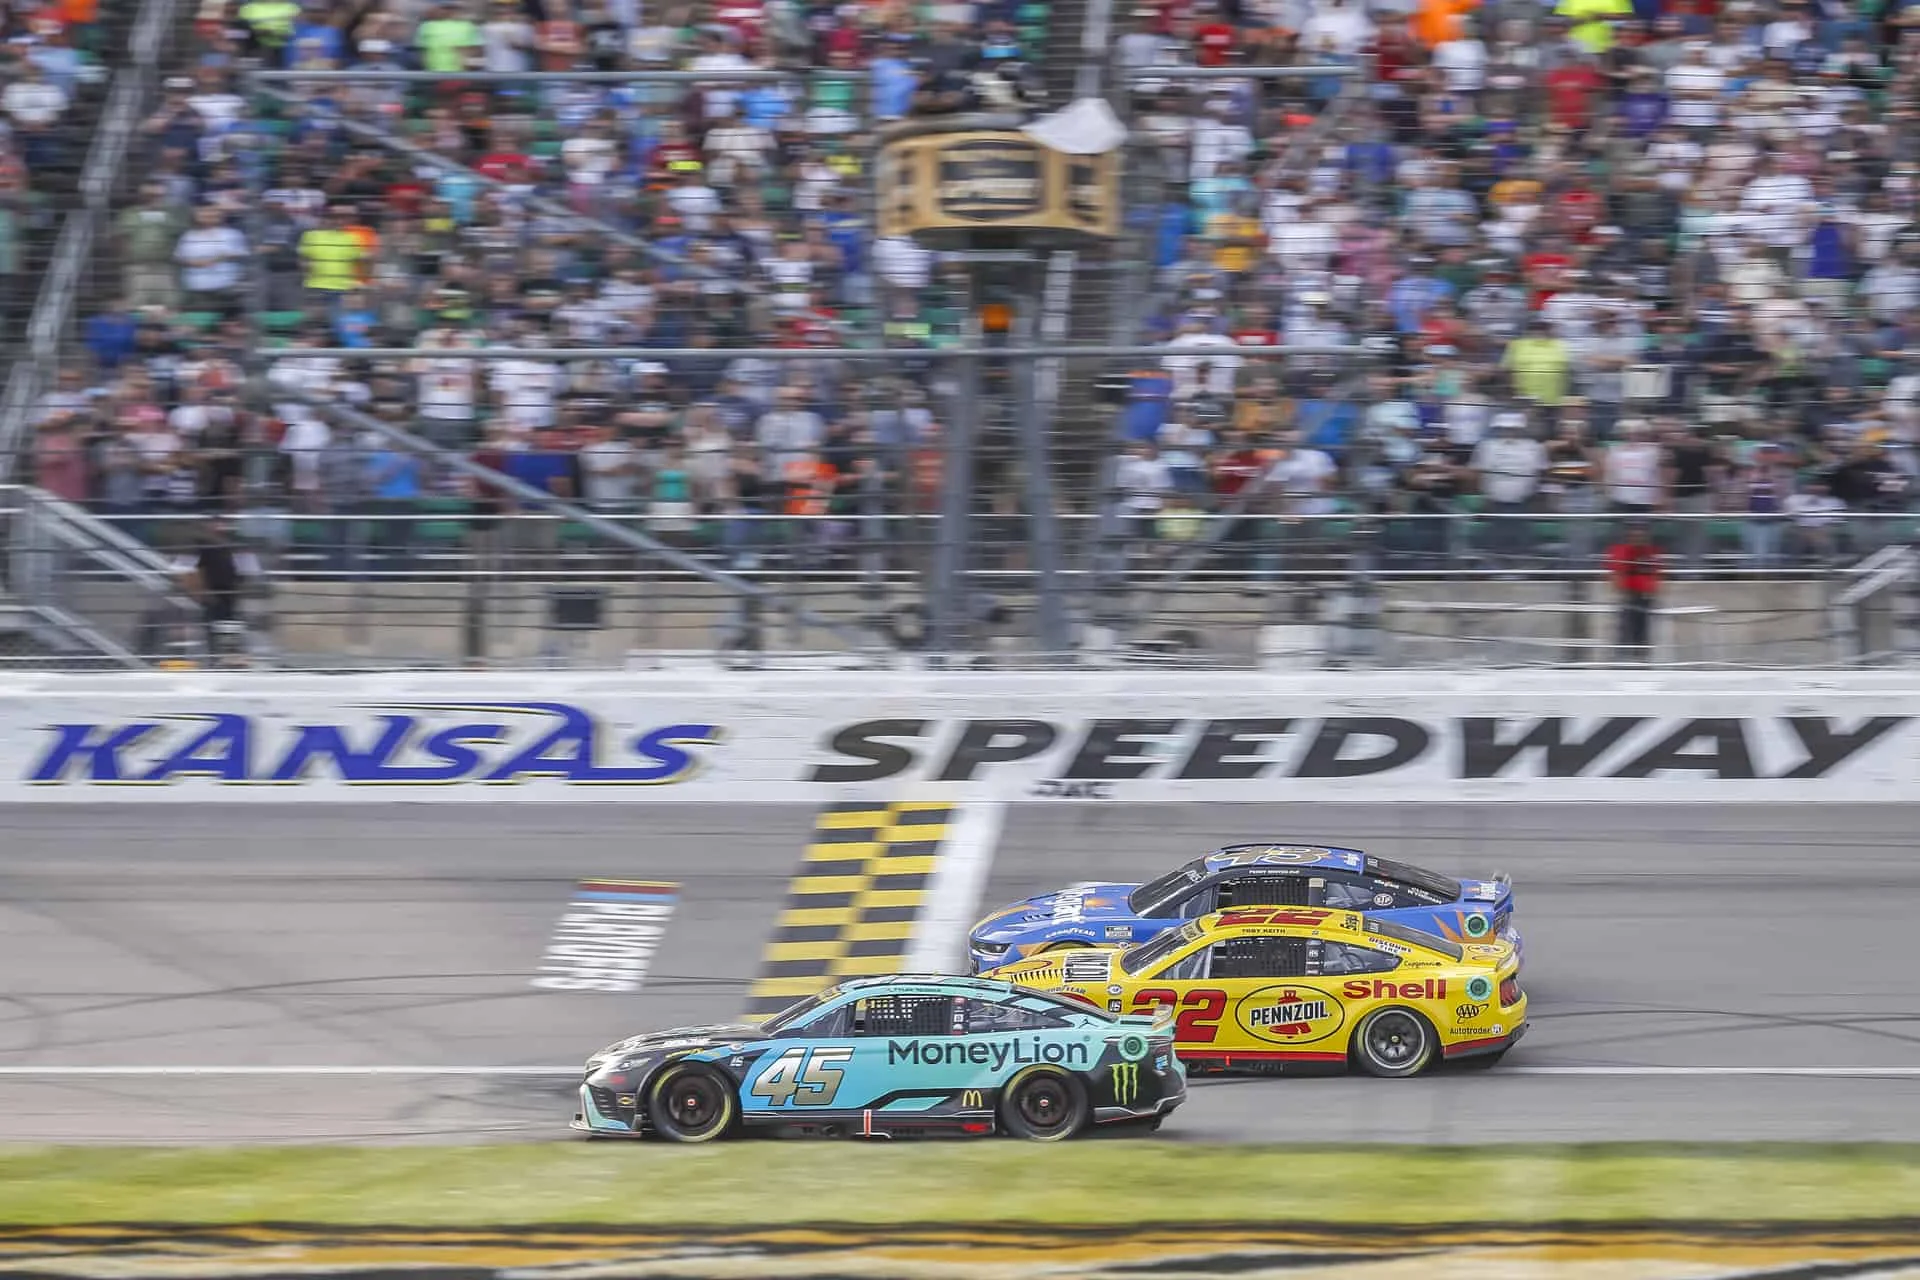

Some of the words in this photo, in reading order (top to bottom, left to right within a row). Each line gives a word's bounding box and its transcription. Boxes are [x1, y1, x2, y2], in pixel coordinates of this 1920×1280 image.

[28, 703, 722, 786] KANSAS
[807, 716, 1910, 781] SPEEDWAY
[529, 901, 676, 992] PLAYOFFS
[1343, 979, 1447, 1000] Shell
[1250, 1001, 1328, 1027] PENNZOIL
[1457, 1004, 1479, 1018] AAA
[1450, 1027, 1491, 1035] Autotrader
[888, 1036, 1088, 1071] MoneyLion
[751, 1047, 855, 1106] 45
